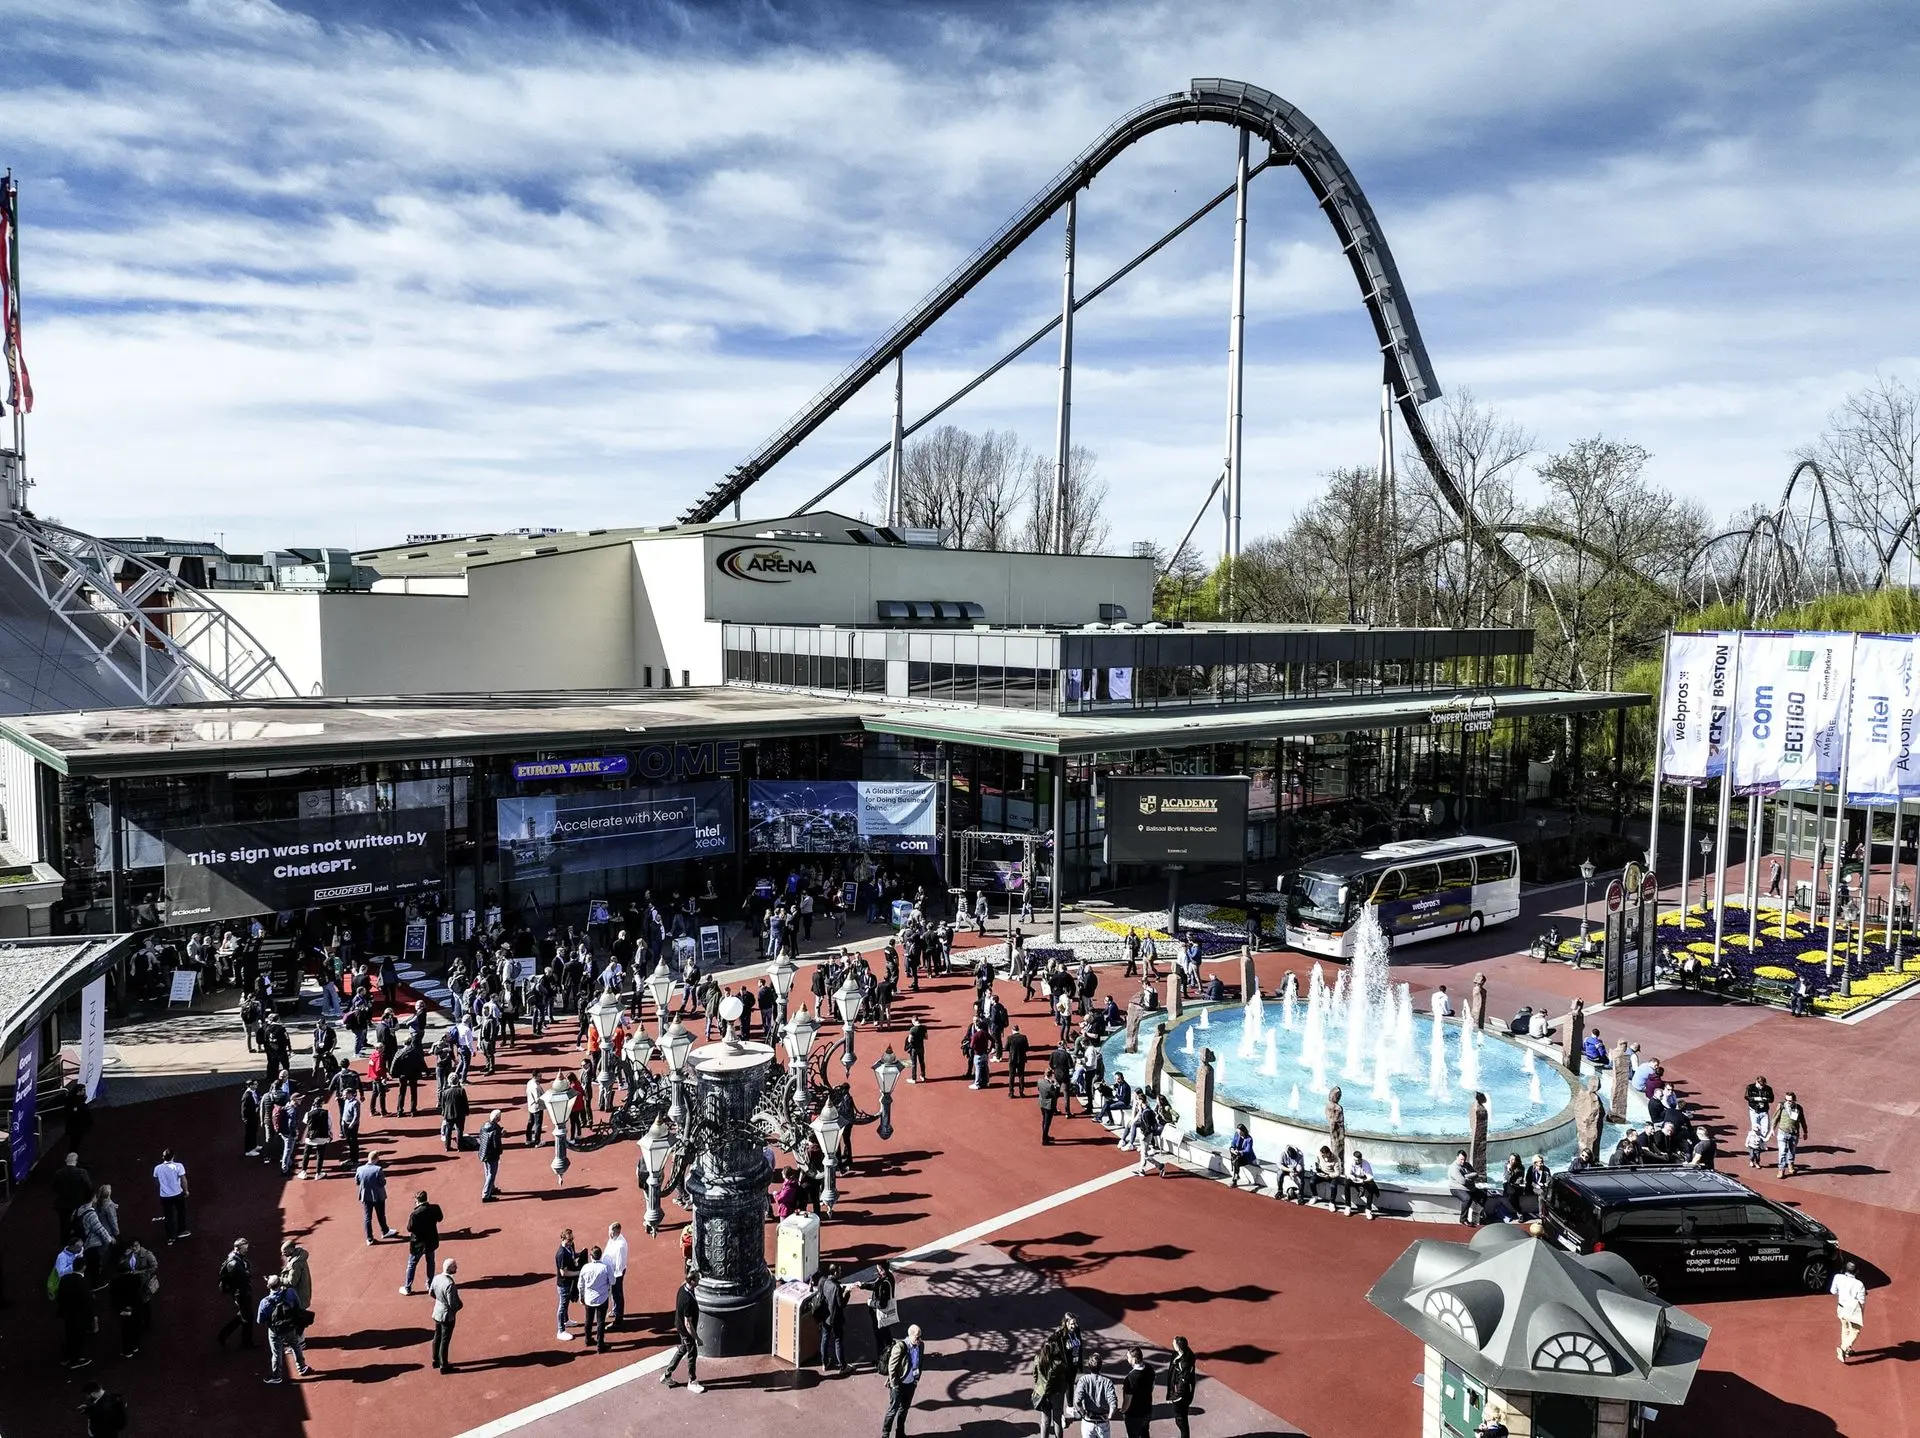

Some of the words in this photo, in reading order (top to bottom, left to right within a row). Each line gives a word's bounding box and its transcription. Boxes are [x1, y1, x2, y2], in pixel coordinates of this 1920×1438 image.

[747, 558, 817, 574] ARENA
[1824, 648, 1833, 674] Packard
[1430, 709, 1496, 724] CONFERTAINMENT
[1672, 682, 1691, 741] webpros
[1867, 695, 1889, 744] intel
[1464, 721, 1492, 732] CENTER
[1783, 691, 1806, 764] SECTIGO
[603, 741, 741, 780] DOME
[518, 764, 567, 777] EUROPA
[570, 761, 601, 774] PARK
[1161, 798, 1218, 808] ACADEMY
[554, 814, 623, 833] Accelerate
[625, 811, 651, 825] with
[695, 823, 721, 839] intel
[187, 850, 227, 866] This
[231, 846, 270, 865] sign
[273, 841, 309, 857] was
[313, 836, 342, 853] not
[345, 832, 403, 851] written
[407, 831, 427, 846] by
[895, 840, 928, 850] .com
[273, 857, 357, 879] ChatGPT.
[316, 884, 370, 899] CLOUDFEST
[374, 884, 389, 892] intel
[172, 906, 211, 917] #CloudFest
[1412, 900, 1435, 911] webpros
[1697, 1248, 1737, 1256] rankingCoach
[1686, 1258, 1711, 1266] epages
